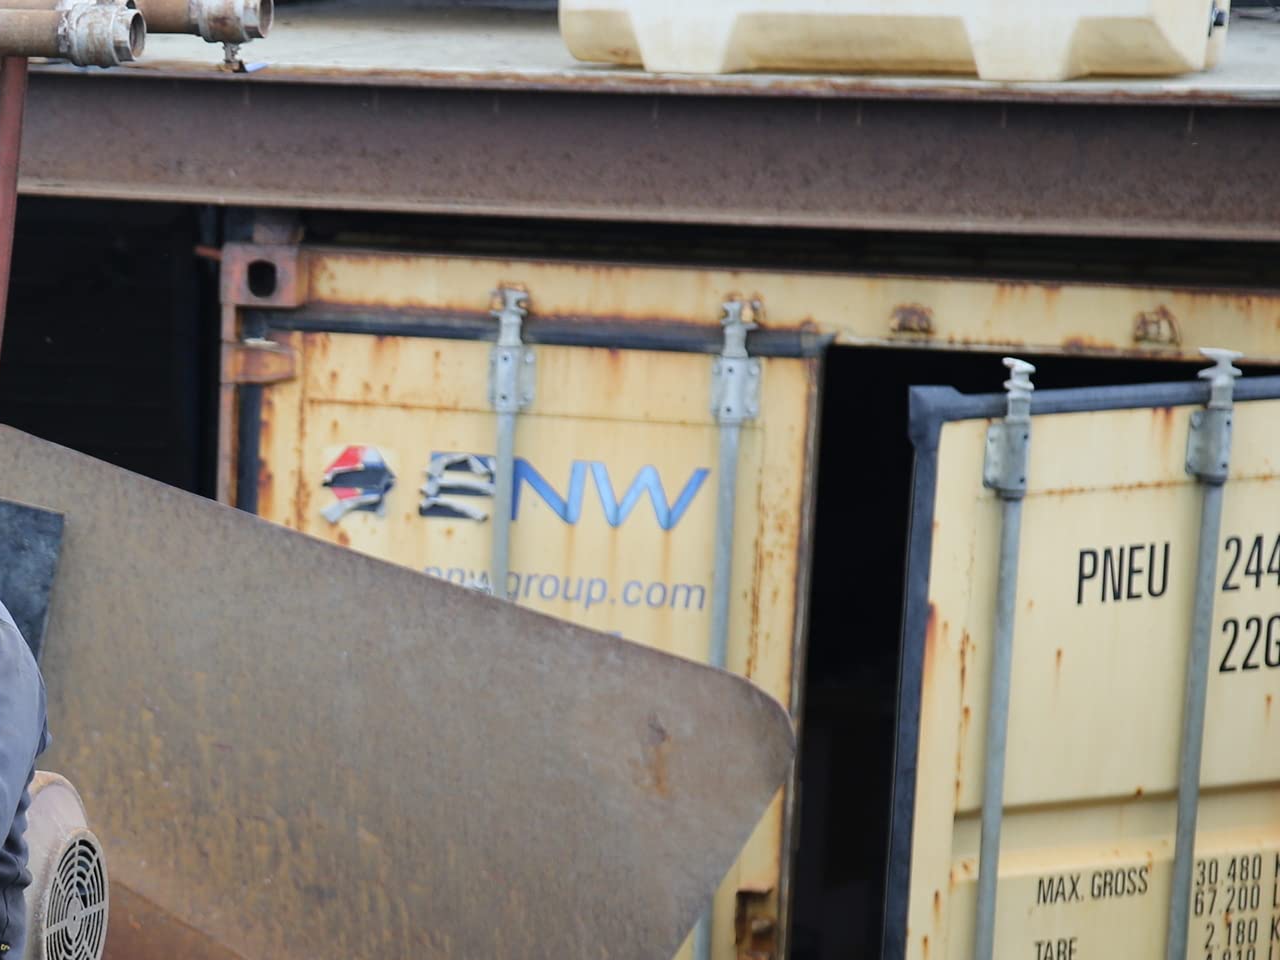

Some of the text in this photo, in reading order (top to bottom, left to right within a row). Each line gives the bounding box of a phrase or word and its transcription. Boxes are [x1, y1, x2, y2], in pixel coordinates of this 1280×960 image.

[419, 451, 710, 530] NW
[1076, 534, 1280, 605] PNEU 244
[1219, 614, 1280, 673] 22G
[1091, 866, 1149, 900] GROSS
